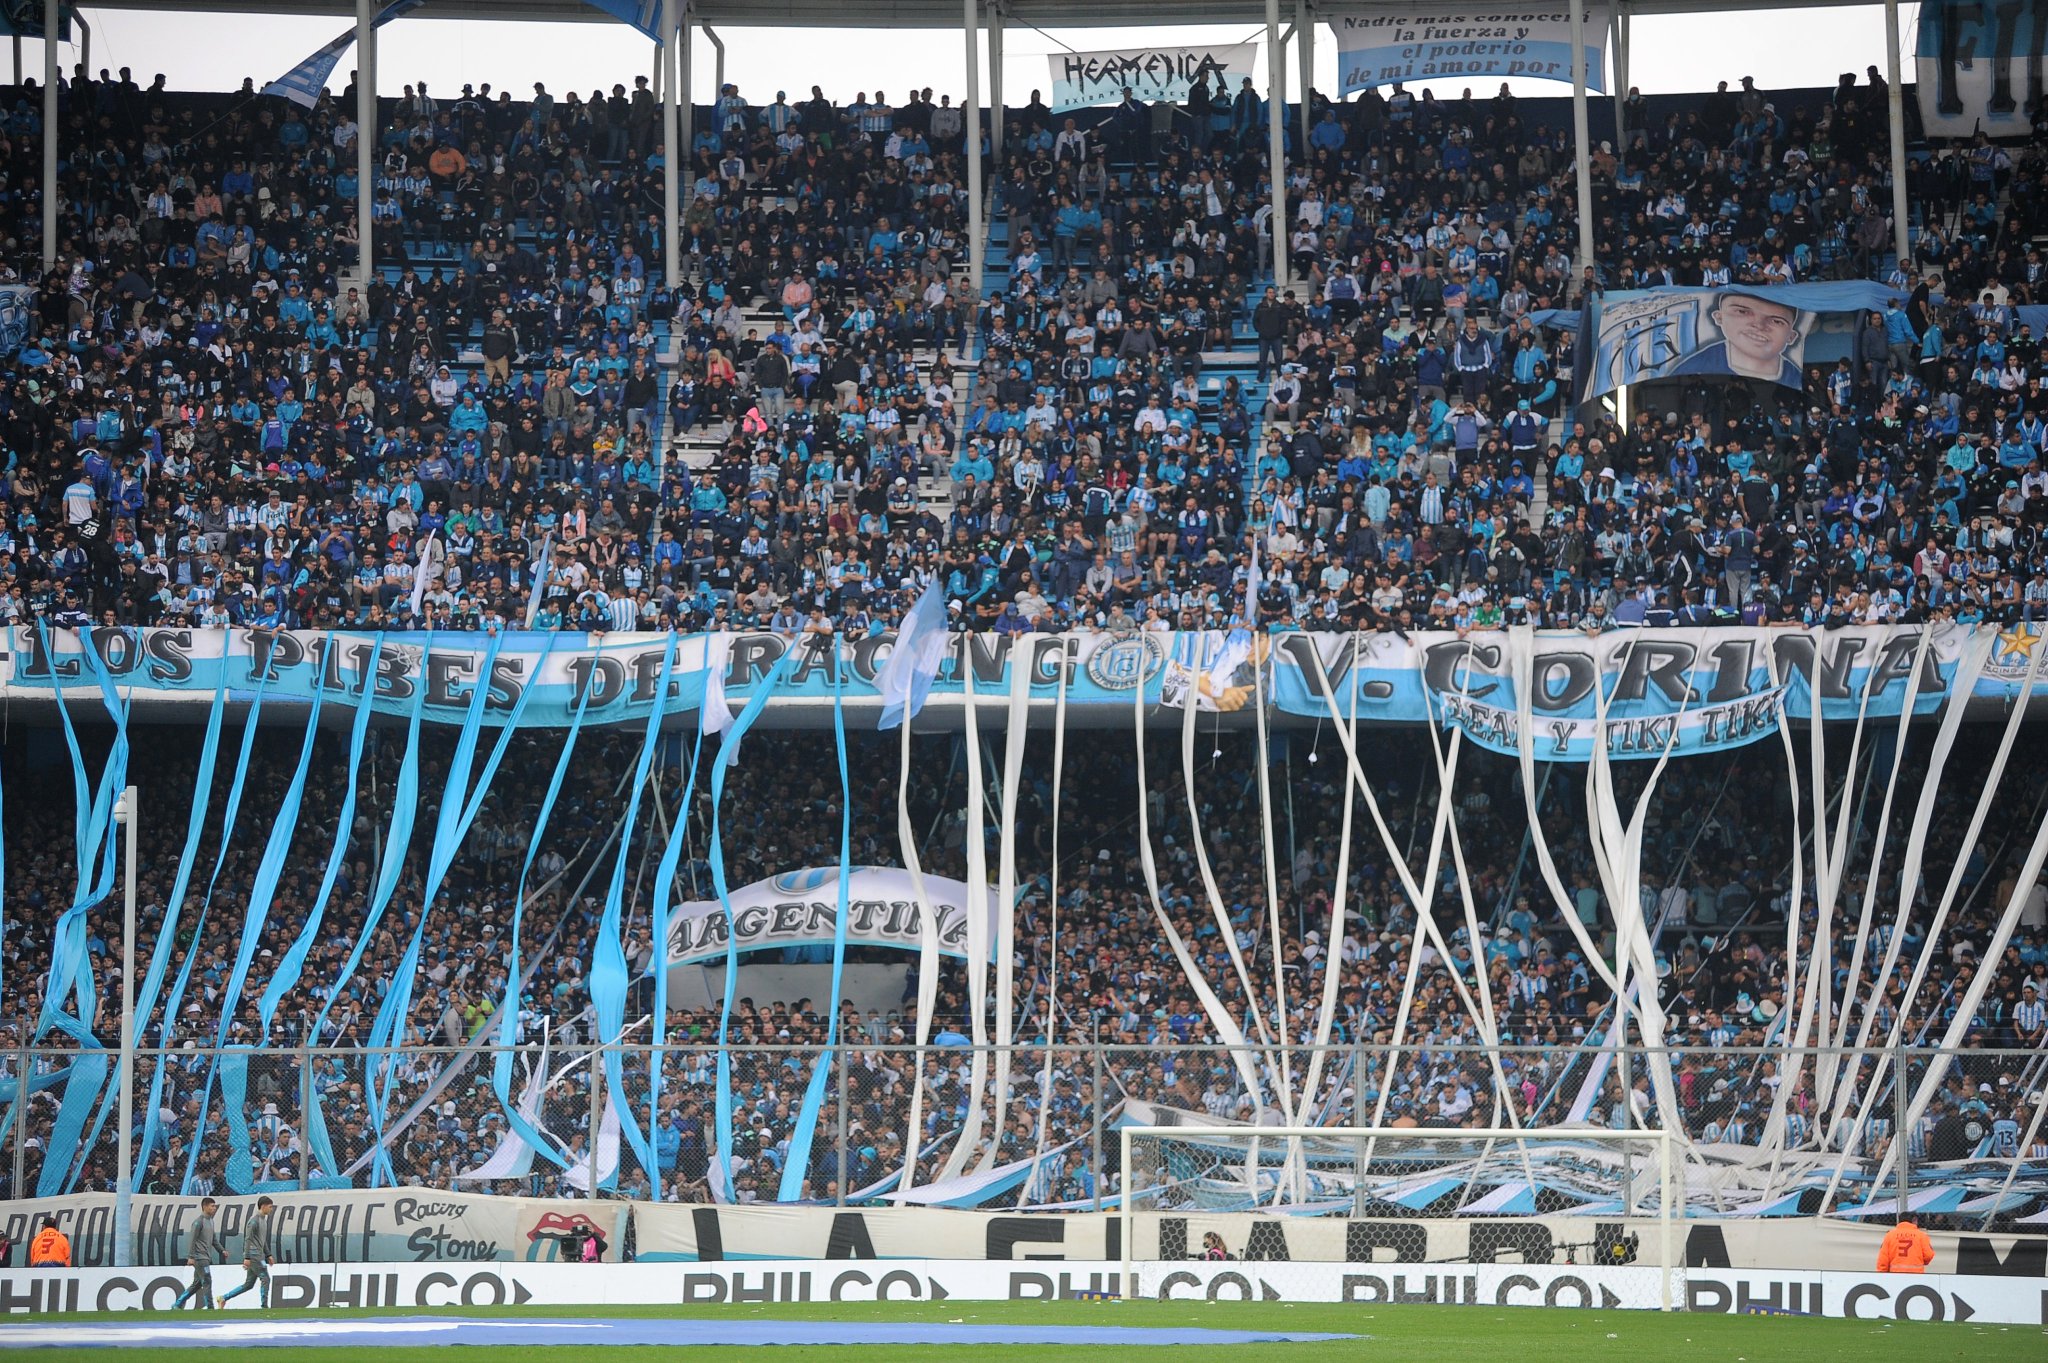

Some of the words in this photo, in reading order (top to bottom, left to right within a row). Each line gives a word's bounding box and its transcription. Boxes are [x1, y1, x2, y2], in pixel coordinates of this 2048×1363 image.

[1344, 16, 1408, 29] Nadie
[1393, 28, 1416, 42] la
[1424, 26, 1507, 40] fuerza
[1513, 27, 1529, 40] y
[1402, 43, 1424, 59] el
[1346, 67, 1372, 87] de
[1380, 60, 1414, 80] mi
[1422, 60, 1500, 75] amor
[1507, 60, 1561, 76] por
[82, 524, 98, 537] 28
[22, 627, 193, 680] LOS
[243, 630, 525, 710] PIBES
[568, 650, 681, 711] DE
[726, 632, 1080, 687] RACNG
[1552, 720, 1578, 751] Y
[1600, 714, 1681, 750] TIKI
[666, 900, 976, 953] ARGENTINA
[1998, 1130, 2014, 1146] 13
[394, 1197, 469, 1226] Racing
[0, 1276, 197, 1313] HILCO
[272, 1271, 506, 1309] PHILCO
[683, 1269, 922, 1304] PHILCO
[1342, 1274, 1593, 1307] PHILCO
[1689, 1278, 1946, 1322] PHILCO
